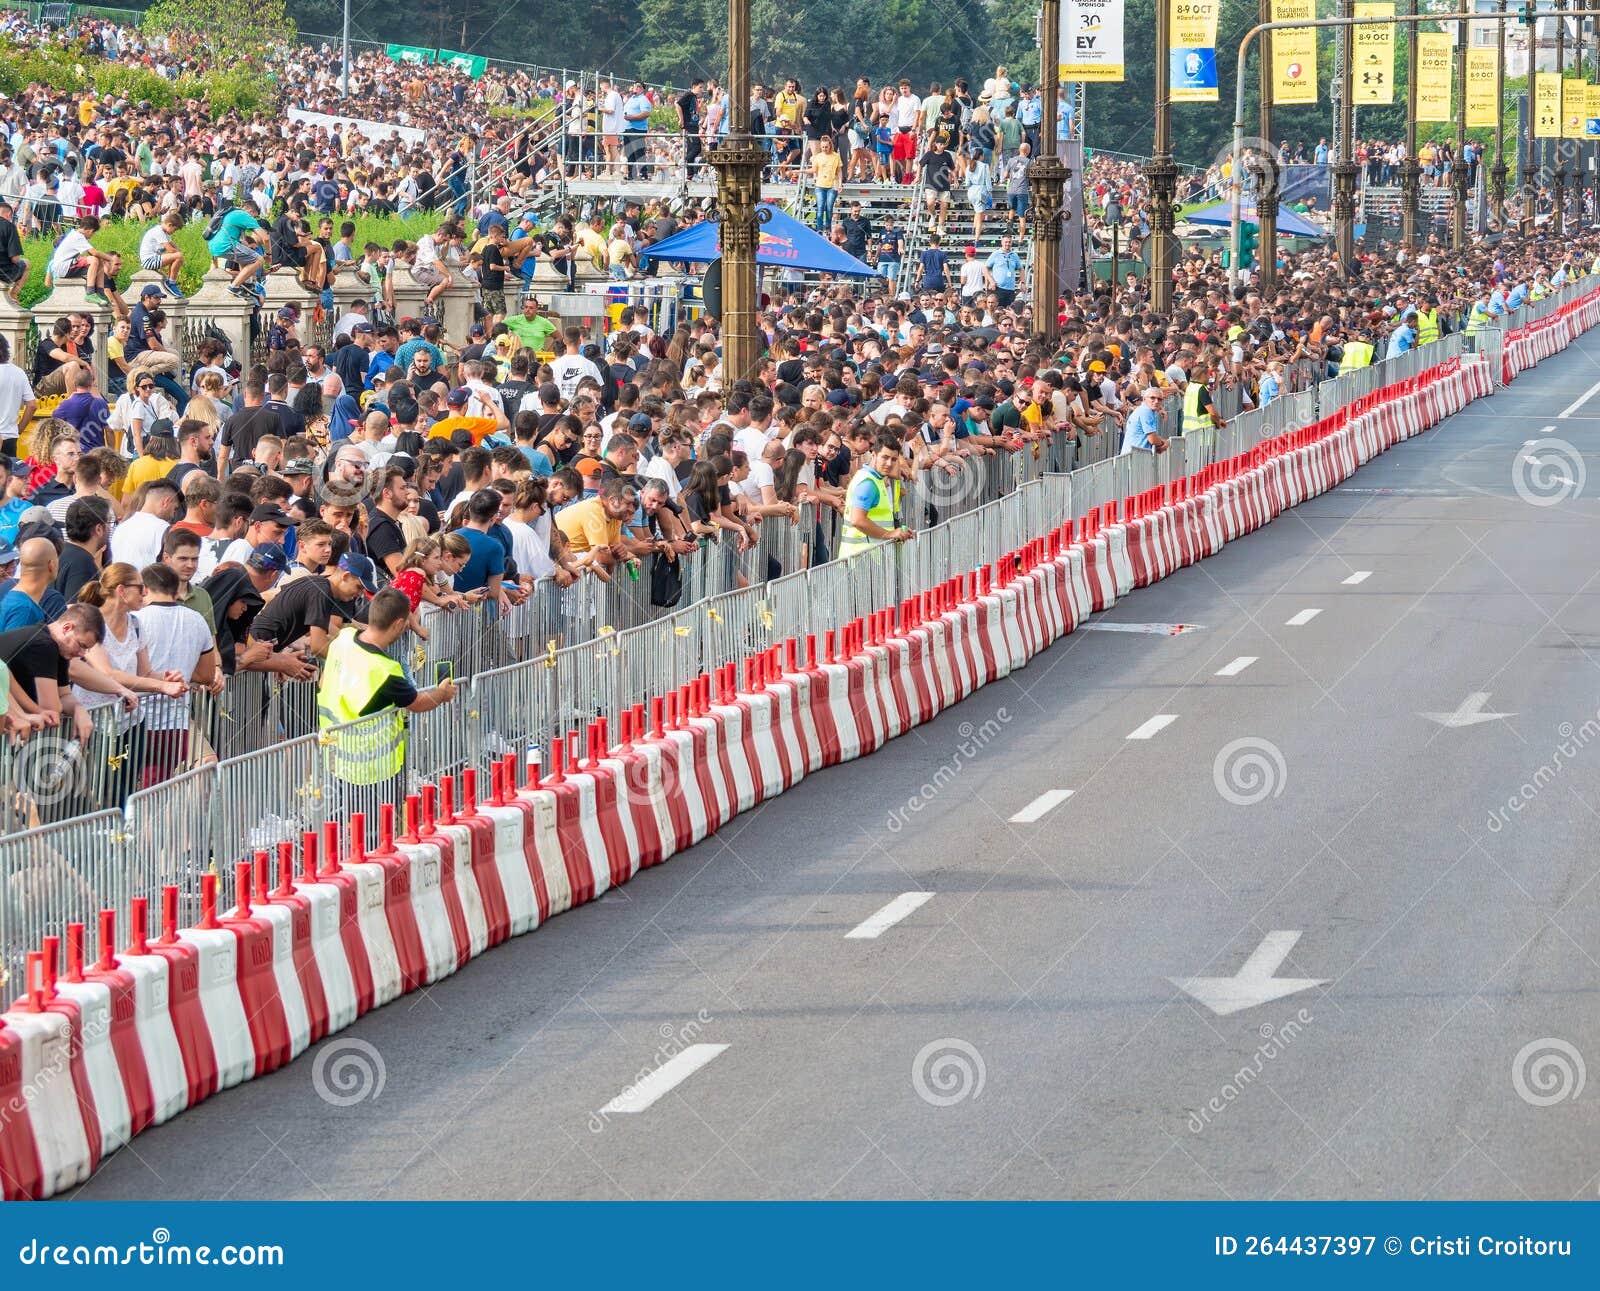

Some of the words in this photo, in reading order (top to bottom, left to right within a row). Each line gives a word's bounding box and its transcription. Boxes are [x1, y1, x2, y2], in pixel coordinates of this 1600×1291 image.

[1177, 5, 1190, 13] 8-9
[1193, 5, 1212, 13] OCT
[1080, 15, 1101, 29] 30
[1076, 36, 1096, 48] EY
[759, 245, 798, 260] Bull
[566, 367, 580, 376] NIKE
